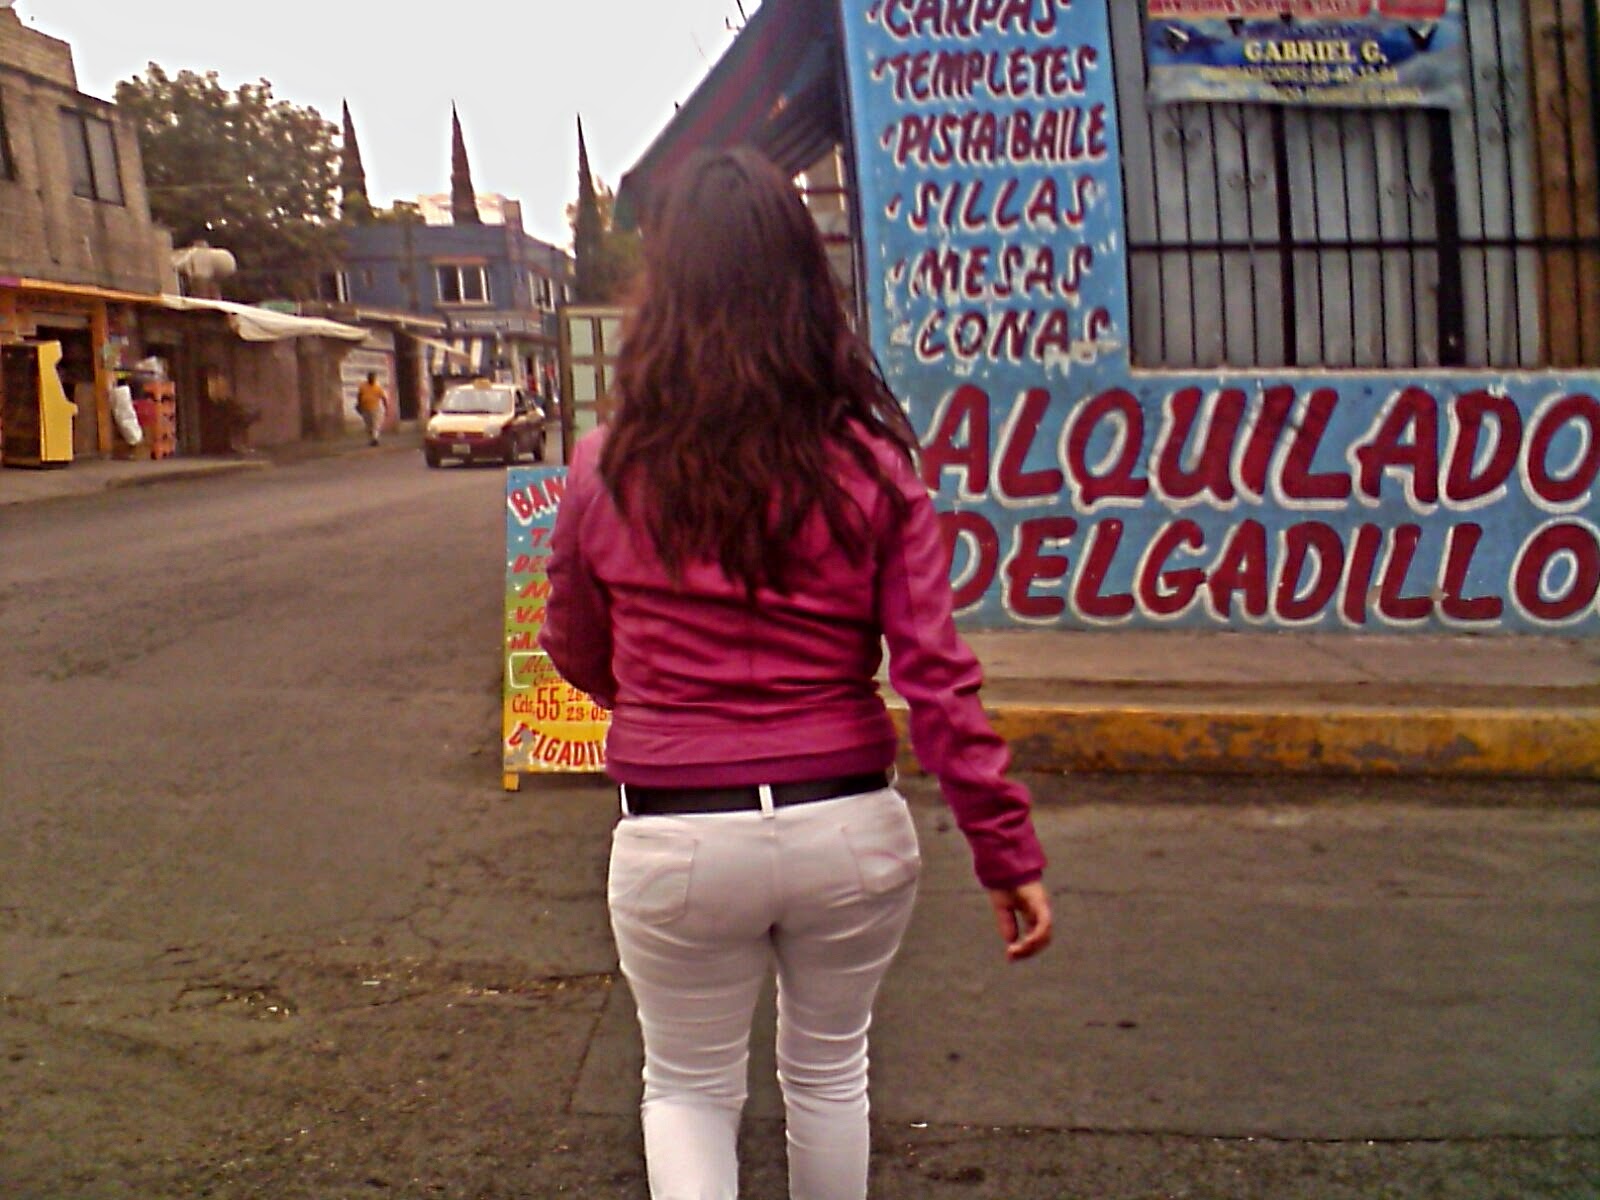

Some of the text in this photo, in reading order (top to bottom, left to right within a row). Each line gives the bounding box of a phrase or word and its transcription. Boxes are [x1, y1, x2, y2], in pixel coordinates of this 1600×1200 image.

[882, 0, 1072, 40] CARPAS
[887, 45, 1097, 103] TEMPLETES
[1244, 39, 1357, 65] GABRIEL
[1009, 104, 1108, 165] BAILE
[909, 174, 1097, 234] SILLAS
[910, 246, 1093, 300] MESAS
[916, 386, 1600, 514] ALQUILADO
[938, 511, 1600, 626] DELGADILLO
